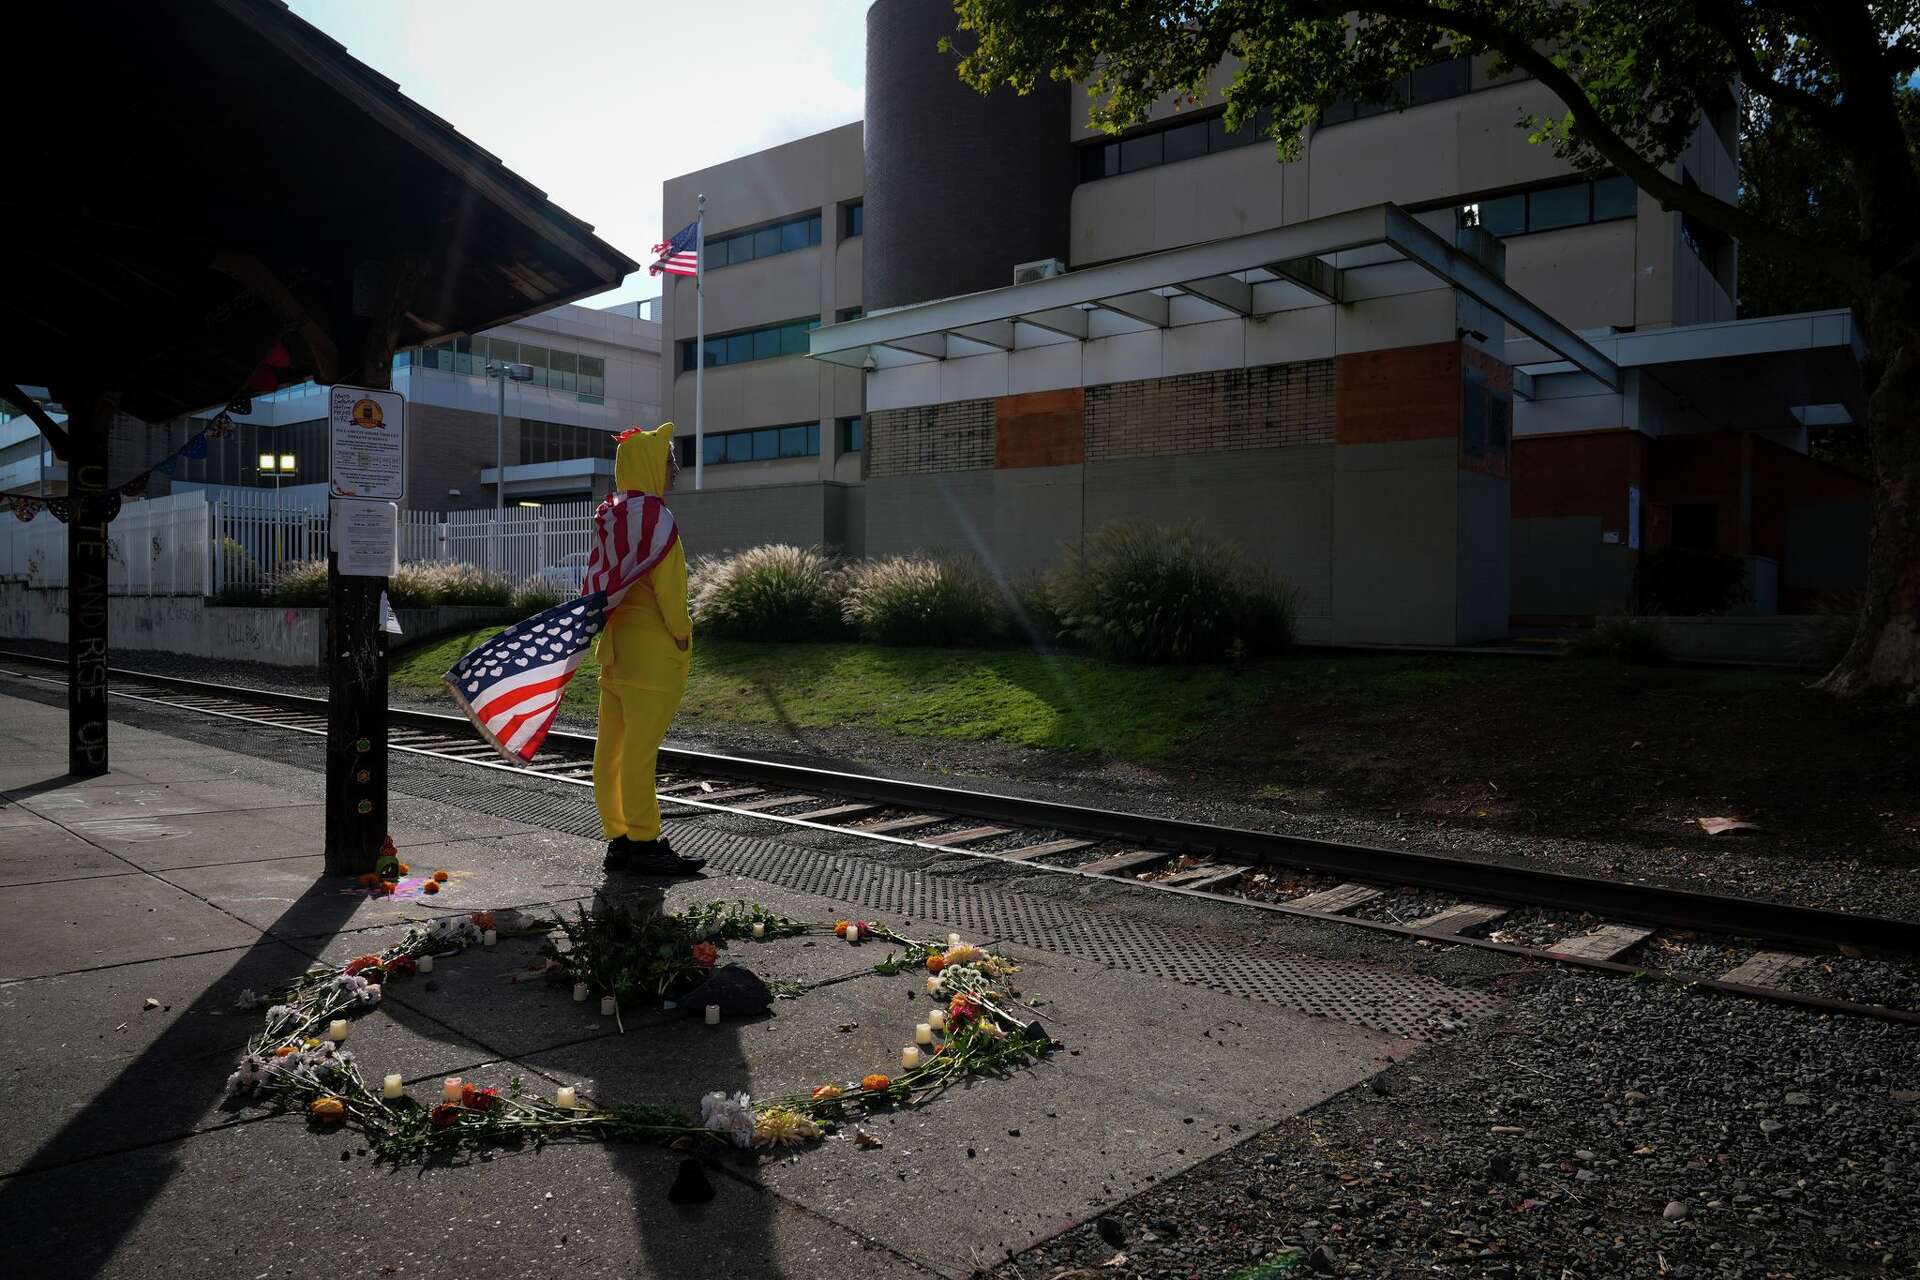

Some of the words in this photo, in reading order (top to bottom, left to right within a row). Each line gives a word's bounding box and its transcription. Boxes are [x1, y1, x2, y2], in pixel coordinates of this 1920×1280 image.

[76, 464, 107, 560] UTE
[79, 568, 105, 628] AND
[76, 637, 107, 704] RISE
[76, 721, 107, 766] UP
